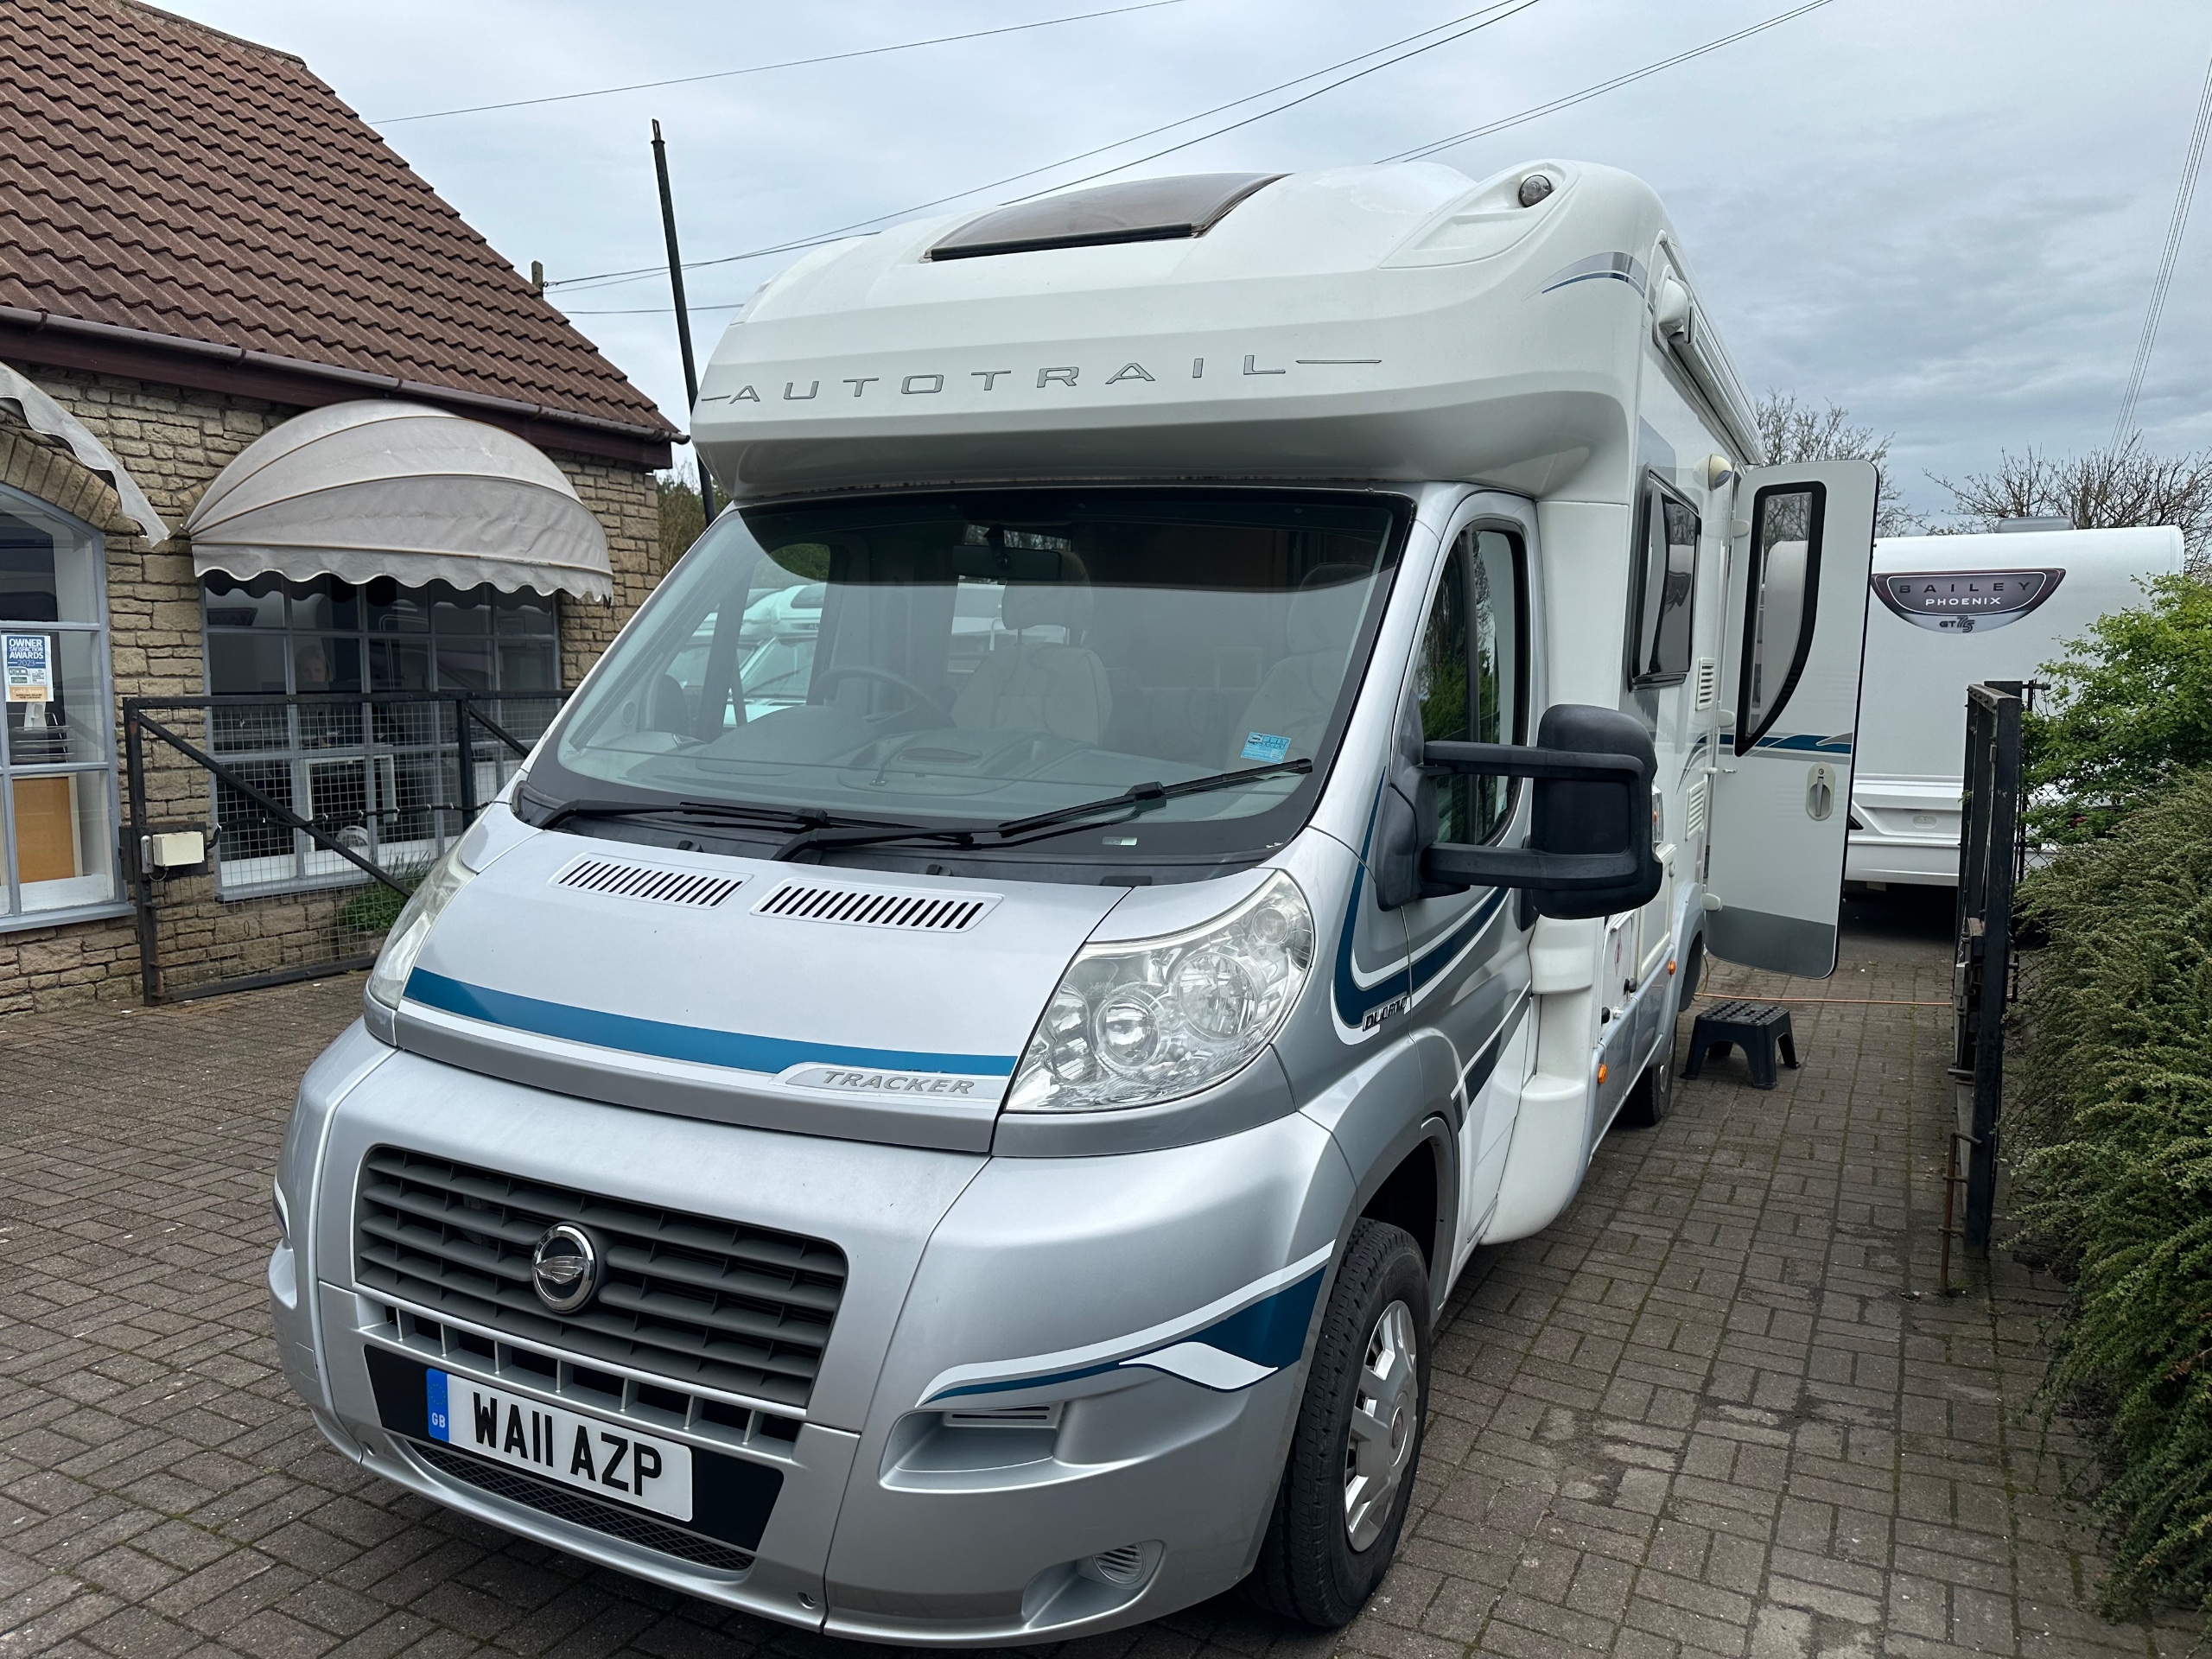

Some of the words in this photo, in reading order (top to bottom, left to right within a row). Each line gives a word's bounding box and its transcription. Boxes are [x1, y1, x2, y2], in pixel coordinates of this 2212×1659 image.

[728, 353, 1287, 404] AUTOTRAIL
[1898, 582, 2031, 594] BAILEY
[1925, 597, 2001, 606] PHOENIX
[9, 639, 42, 647] OWNER
[822, 1071, 975, 1094] TRACKER
[431, 1412, 446, 1428] GB
[570, 1424, 663, 1497] AZP
